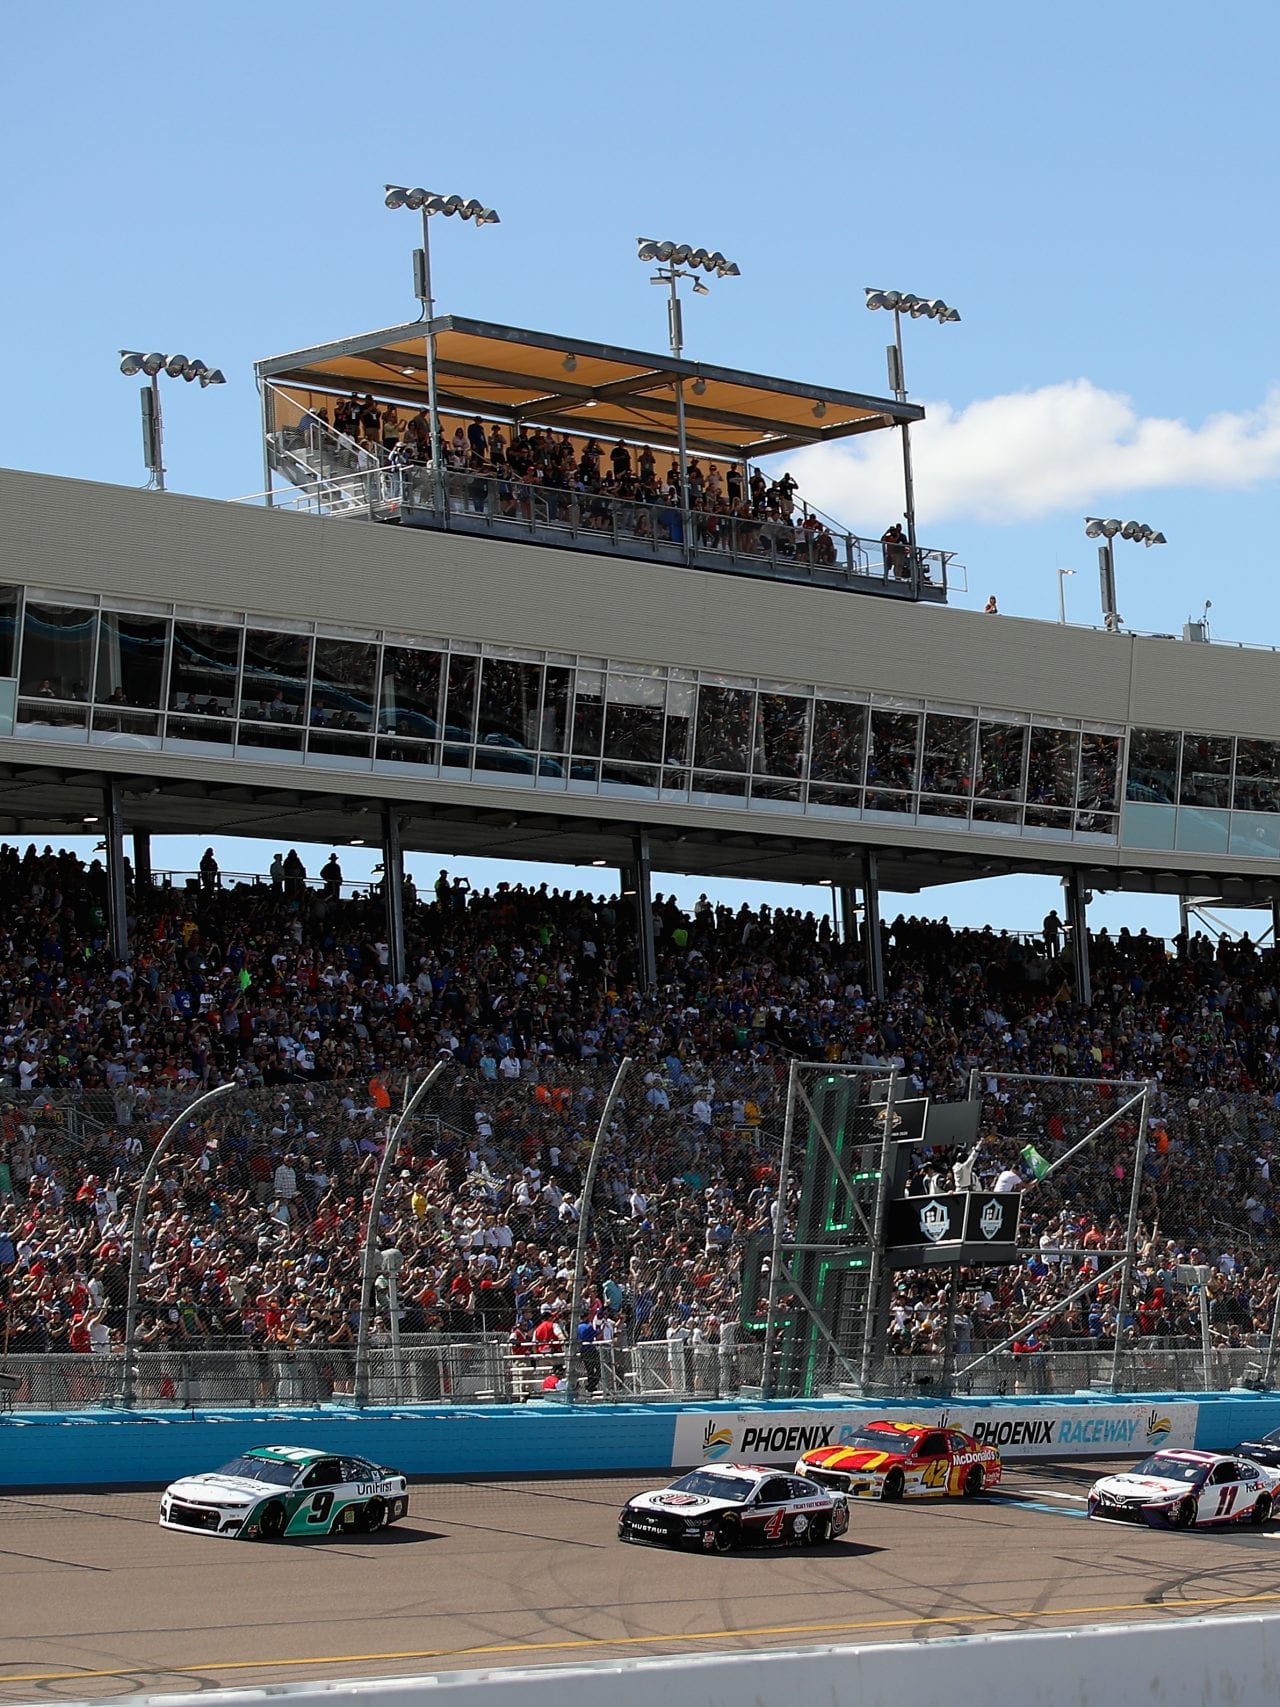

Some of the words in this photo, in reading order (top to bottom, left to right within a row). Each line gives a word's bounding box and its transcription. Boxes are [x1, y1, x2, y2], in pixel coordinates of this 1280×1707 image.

[740, 1426, 835, 1453] PHOENIX
[972, 1420, 1055, 1445] PHOENIX
[1057, 1419, 1140, 1444] RACEWAY
[953, 1450, 995, 1466] McDonald's
[920, 1459, 950, 1489] 42
[356, 1481, 393, 1496] UniFirst
[1214, 1486, 1239, 1516] 11
[306, 1491, 335, 1524] 9
[763, 1507, 787, 1539] 4
